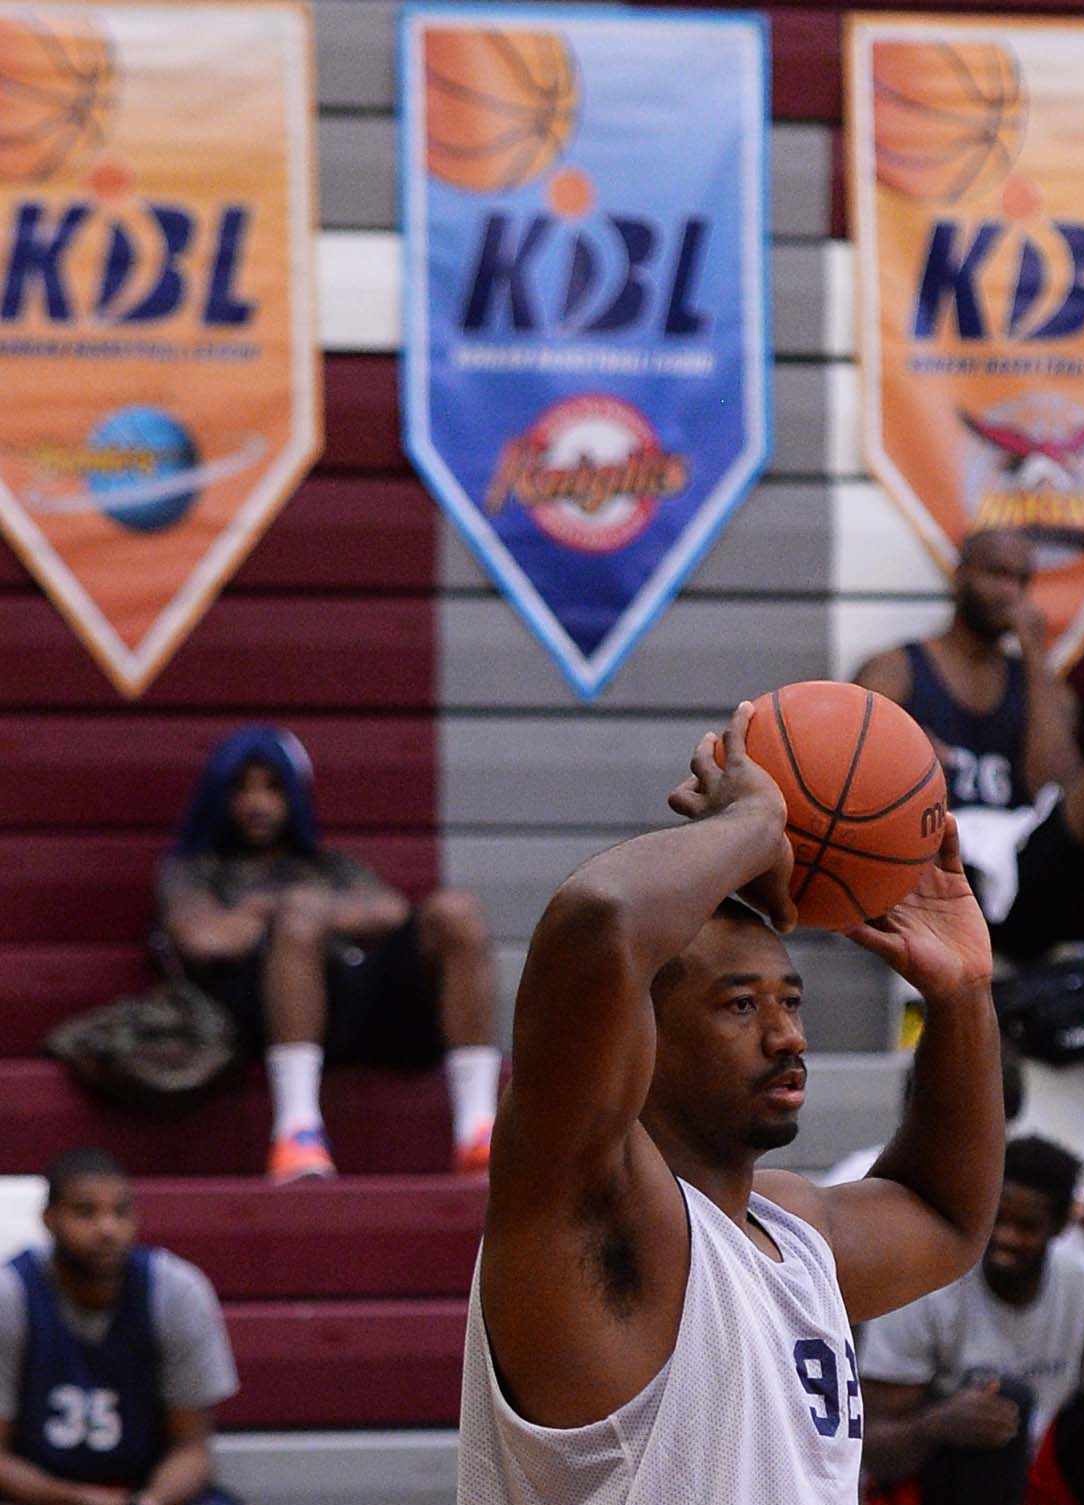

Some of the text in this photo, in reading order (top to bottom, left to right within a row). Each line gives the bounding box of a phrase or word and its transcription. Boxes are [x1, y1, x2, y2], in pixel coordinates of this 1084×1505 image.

[2, 204, 256, 326] KBL
[462, 213, 710, 337] KBL
[43, 1384, 123, 1452] 35
